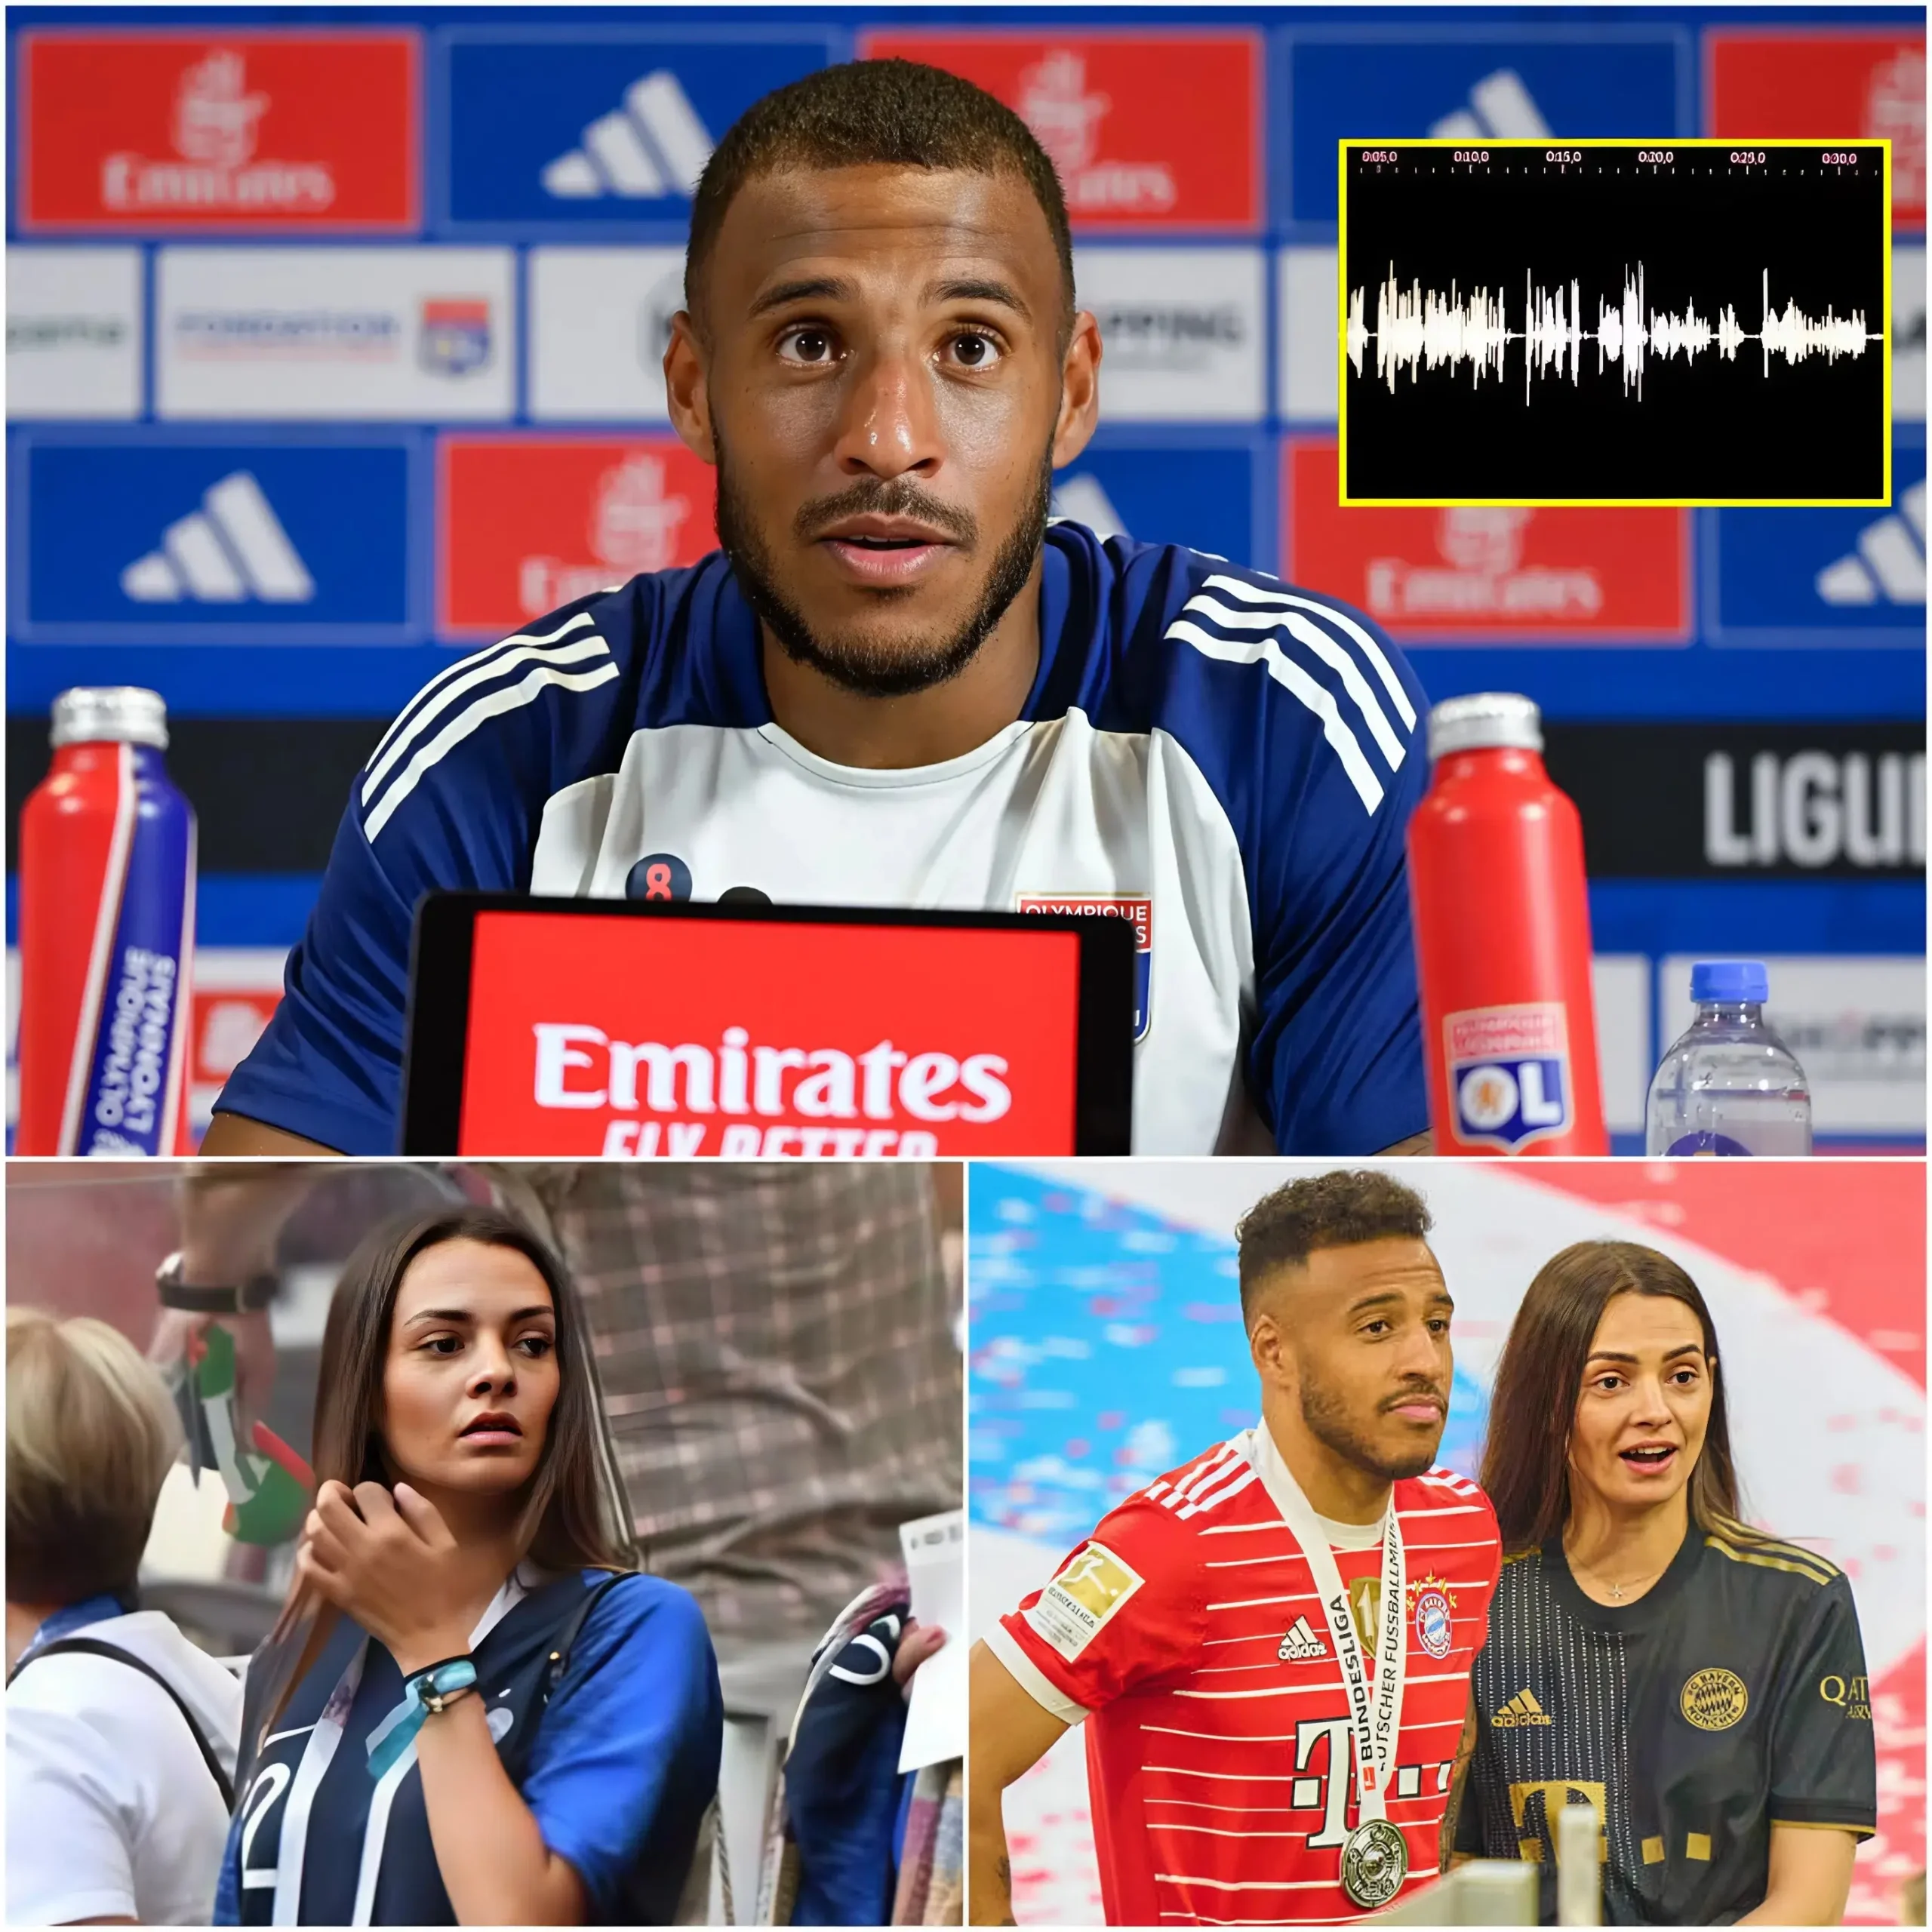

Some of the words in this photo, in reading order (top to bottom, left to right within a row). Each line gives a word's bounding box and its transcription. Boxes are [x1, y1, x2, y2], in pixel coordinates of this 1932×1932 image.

[95, 946, 152, 1128] OLYMPIQUE
[532, 1022, 1013, 1123] Emirates
[1460, 1061, 1564, 1131] OL
[1278, 1641, 1327, 1660] adidas
[1330, 1594, 1374, 1761] BUNDESLIGA
